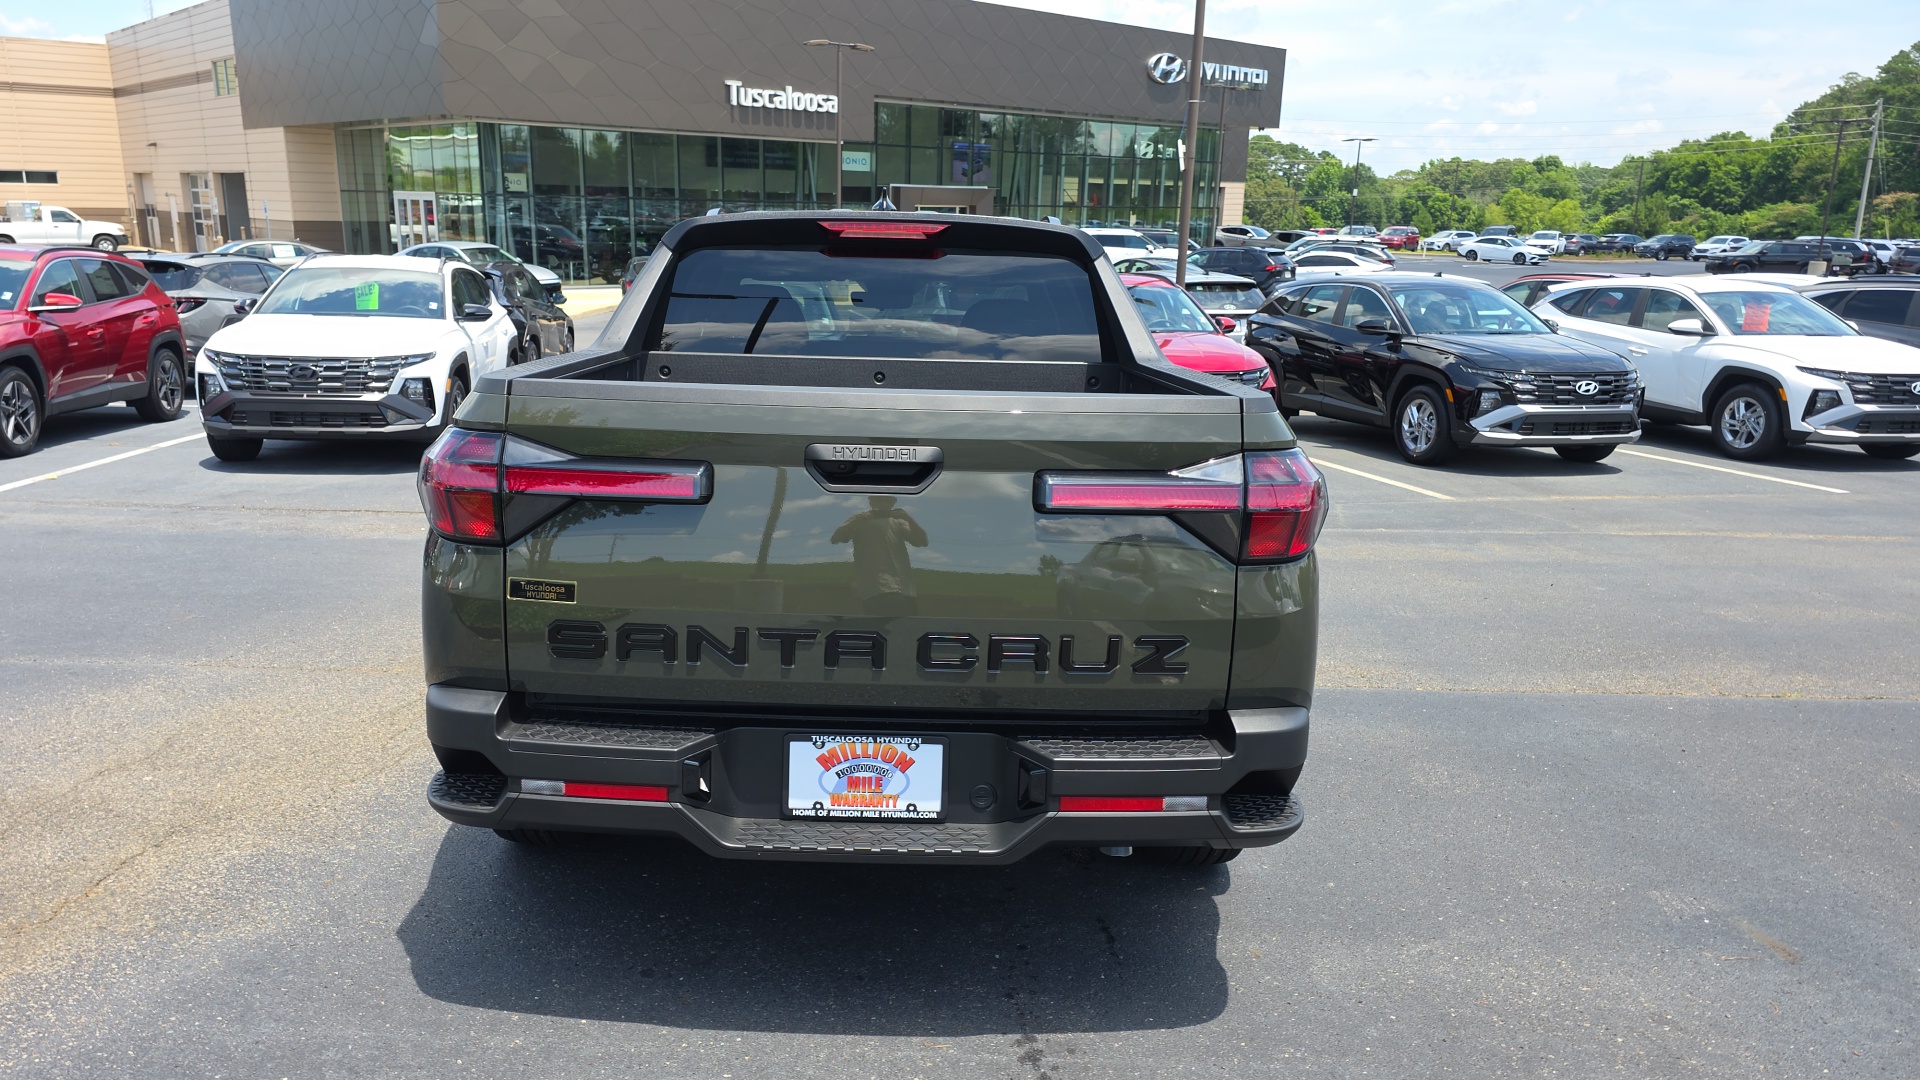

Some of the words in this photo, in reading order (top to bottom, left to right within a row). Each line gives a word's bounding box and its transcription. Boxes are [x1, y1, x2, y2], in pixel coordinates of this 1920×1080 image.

[724, 79, 838, 114] Tuscaloosa
[842, 157, 867, 165] IONIQ
[832, 446, 917, 461] HYUNDAI
[520, 581, 565, 593] Tuscaloosa
[526, 591, 557, 600] HYUNDAI
[546, 619, 888, 671] SANTA
[916, 631, 1190, 675] CRUZ
[811, 735, 874, 744] TUSCALOOSA
[876, 737, 922, 745] HYUNDAI
[816, 742, 916, 774] MILLION
[847, 776, 883, 793] MILE
[829, 793, 900, 808] WARRANTY
[792, 809, 815, 817] HOME
[829, 810, 861, 818] MILLION
[862, 810, 880, 818] MILE
[881, 811, 938, 819] HYUNDAI.COM
